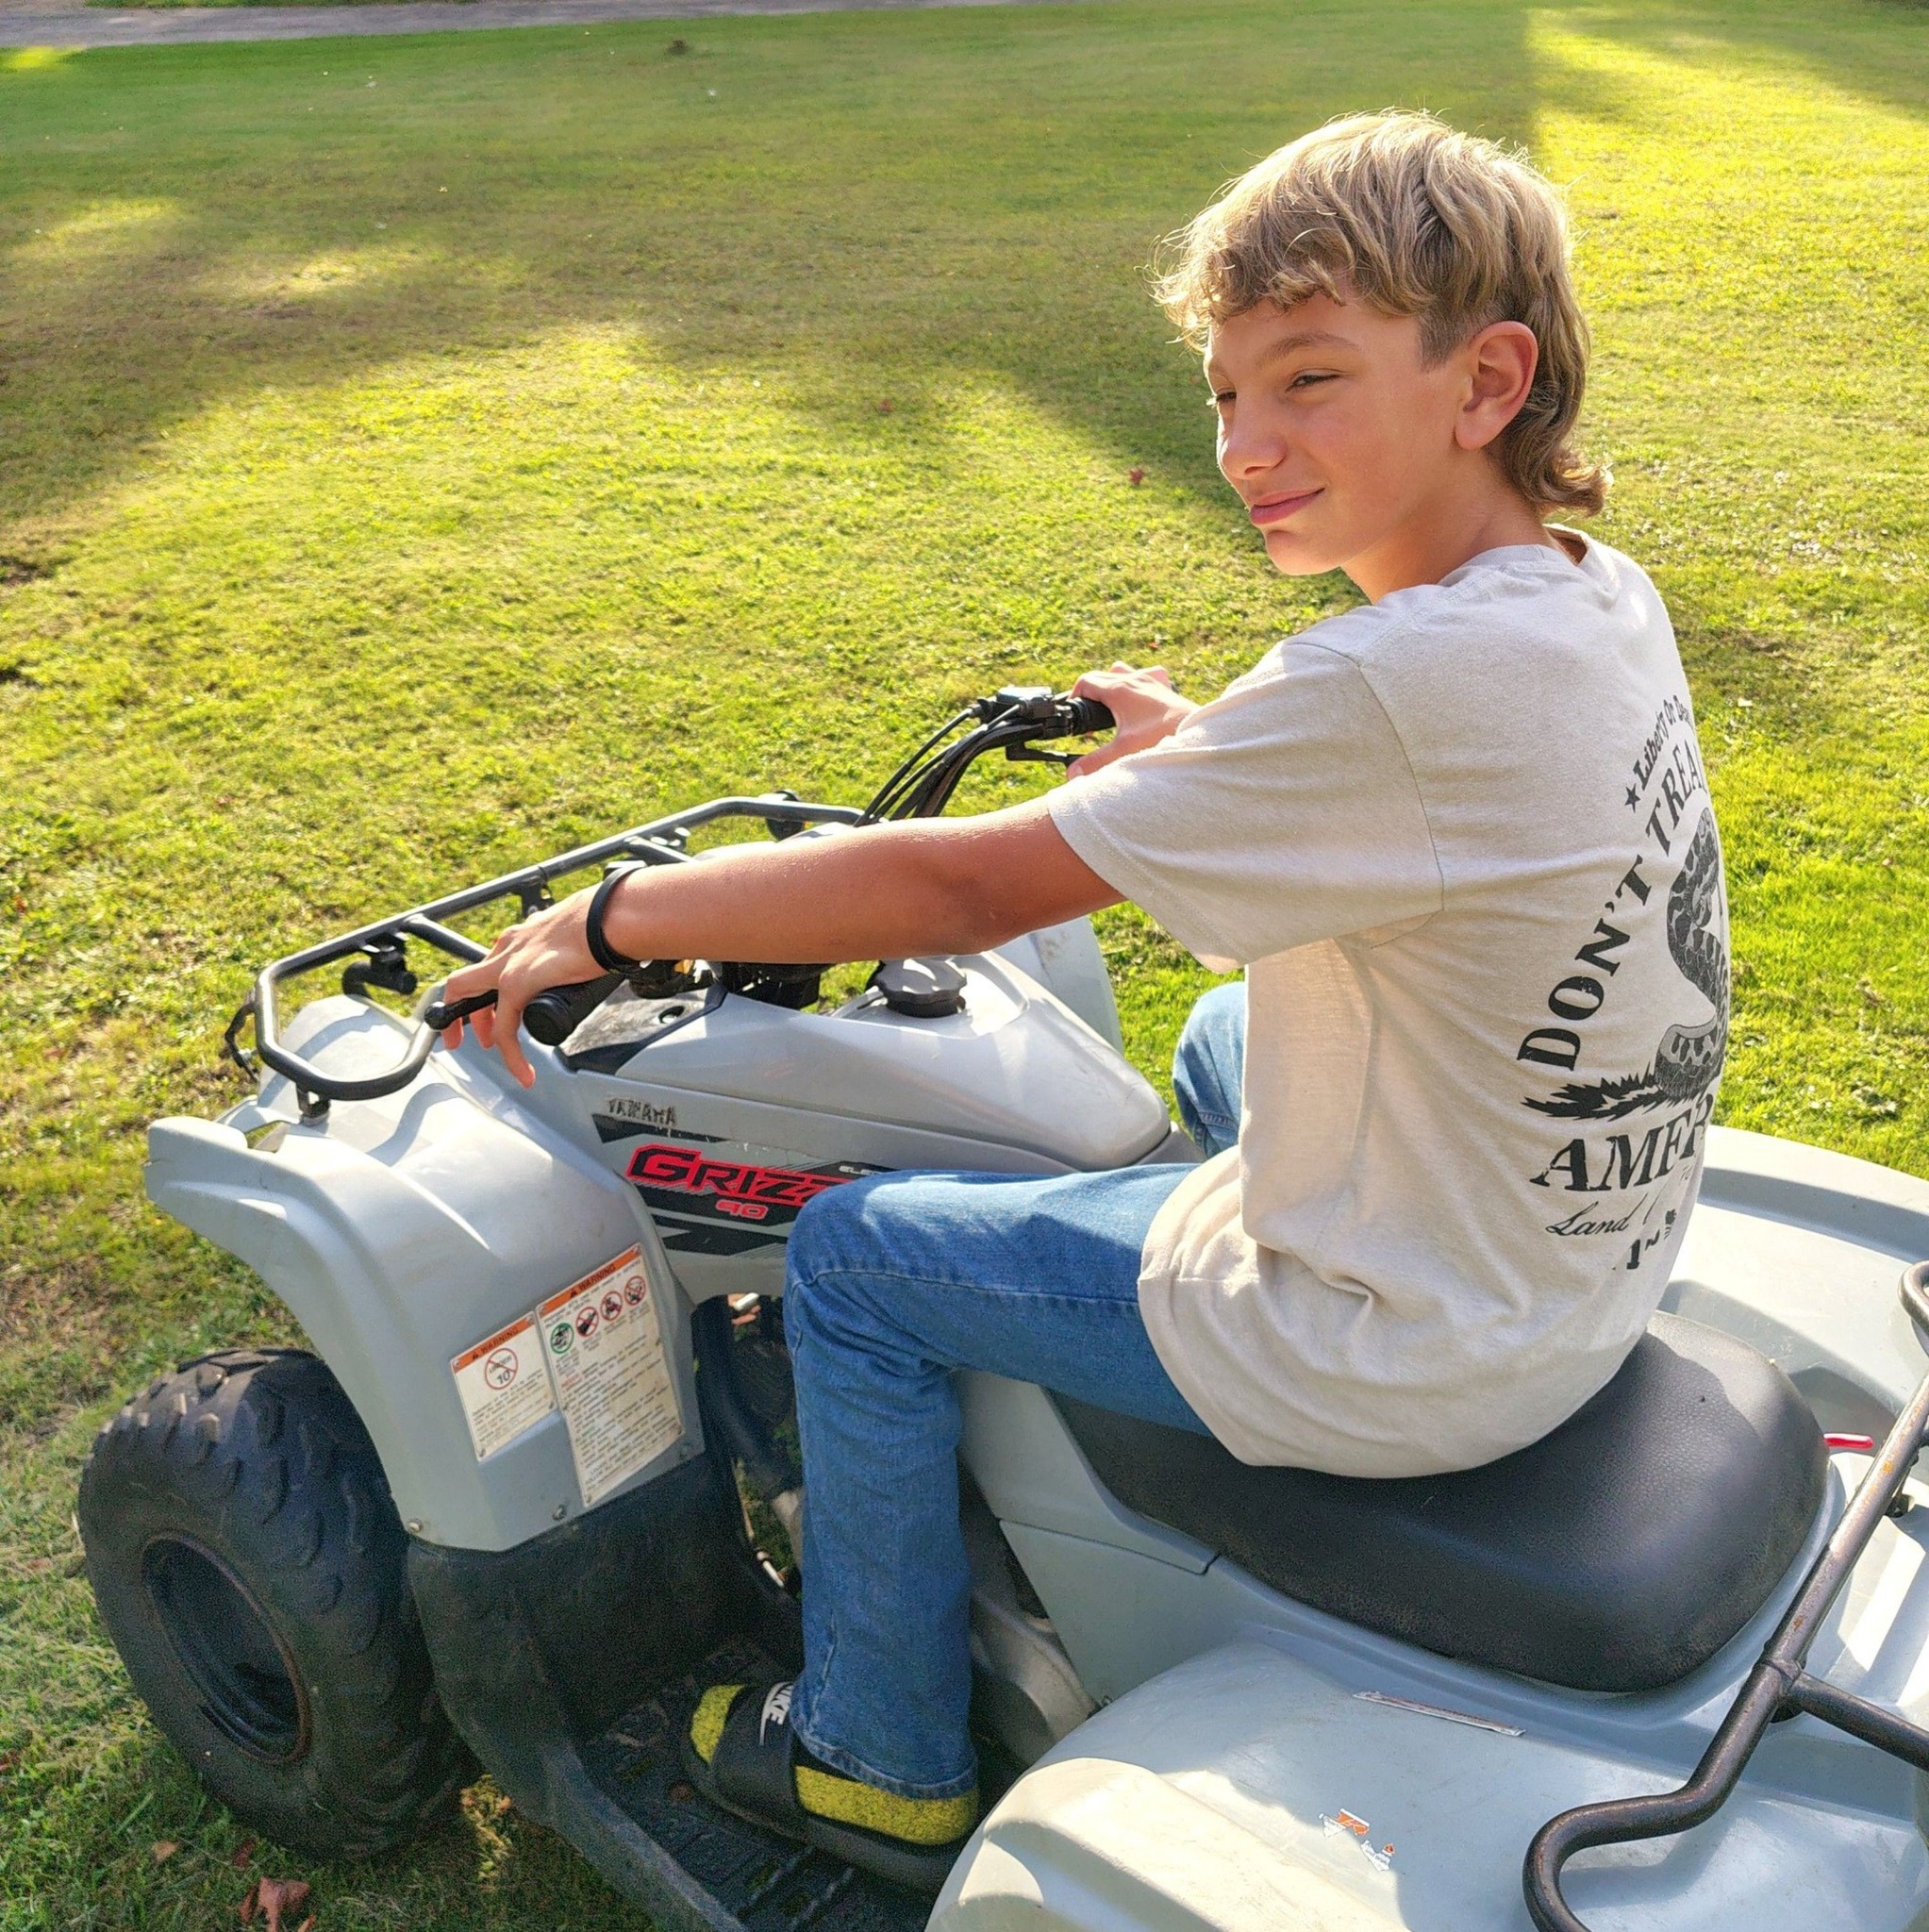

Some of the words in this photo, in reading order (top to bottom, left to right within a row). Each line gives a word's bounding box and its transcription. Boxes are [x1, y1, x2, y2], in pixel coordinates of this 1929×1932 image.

[1633, 710, 1670, 791] Liberty
[1517, 854, 1652, 1072] DON'T
[1645, 739, 1708, 858] TREA
[1545, 1191, 1649, 1237] Land
[578, 1263, 617, 1291] WARNING
[481, 1326, 520, 1353] WARNING
[496, 1369, 511, 1385] 10
